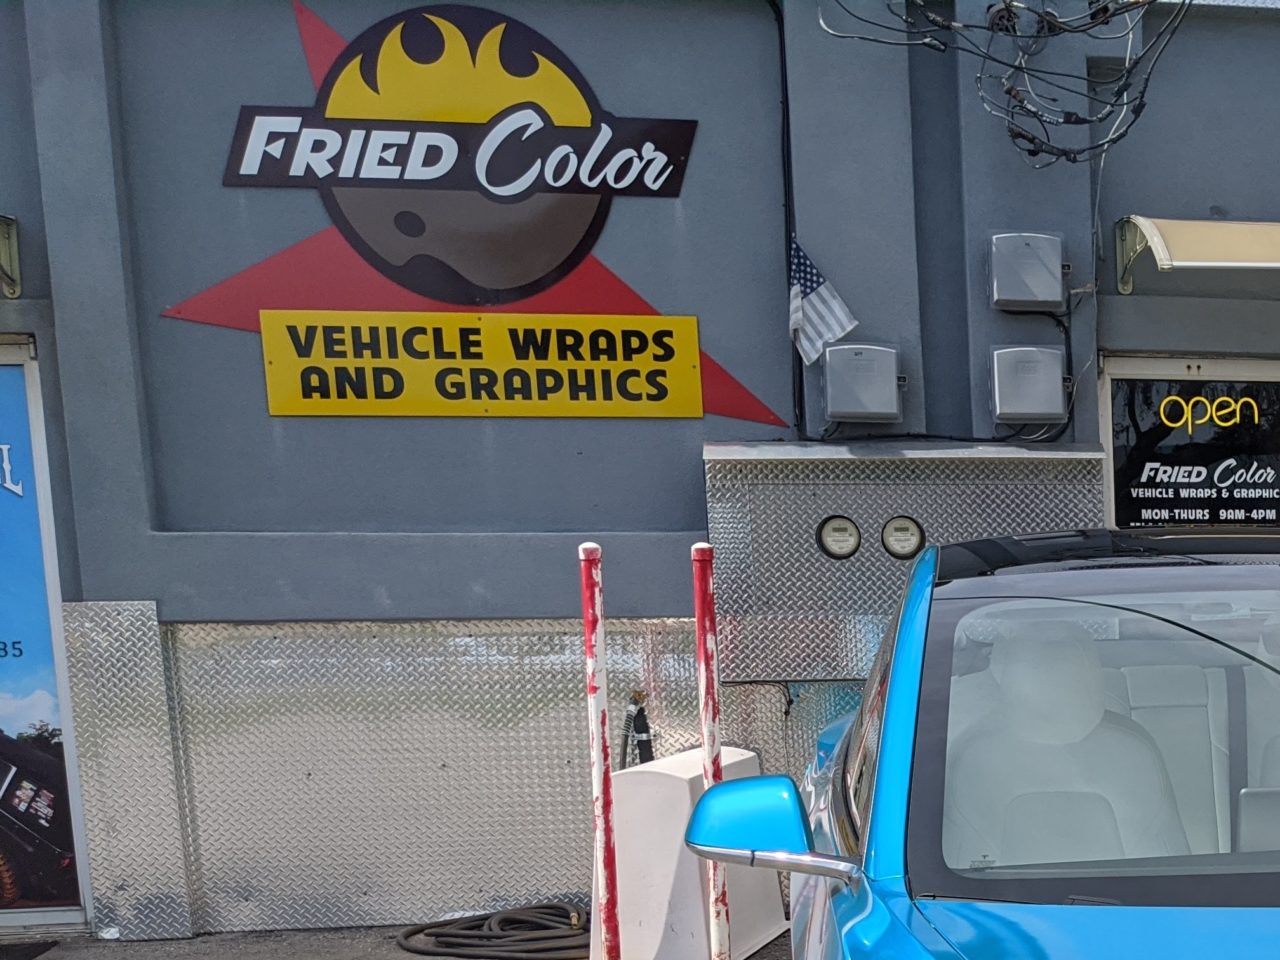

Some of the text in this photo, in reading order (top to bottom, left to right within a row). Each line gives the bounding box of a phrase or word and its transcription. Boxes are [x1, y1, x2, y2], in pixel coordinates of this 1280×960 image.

[239, 108, 678, 197] FRIED Color
[286, 324, 676, 363] VEHICLE WRAPS
[300, 365, 669, 403] AND GRAPHICS
[1140, 458, 1277, 488] FRIED Color
[1131, 488, 1174, 498] VEHICLE
[1180, 488, 1217, 498] WRAPS
[1221, 488, 1230, 498] &
[1141, 509, 1277, 521] MON-THURS 9AM-4PM
